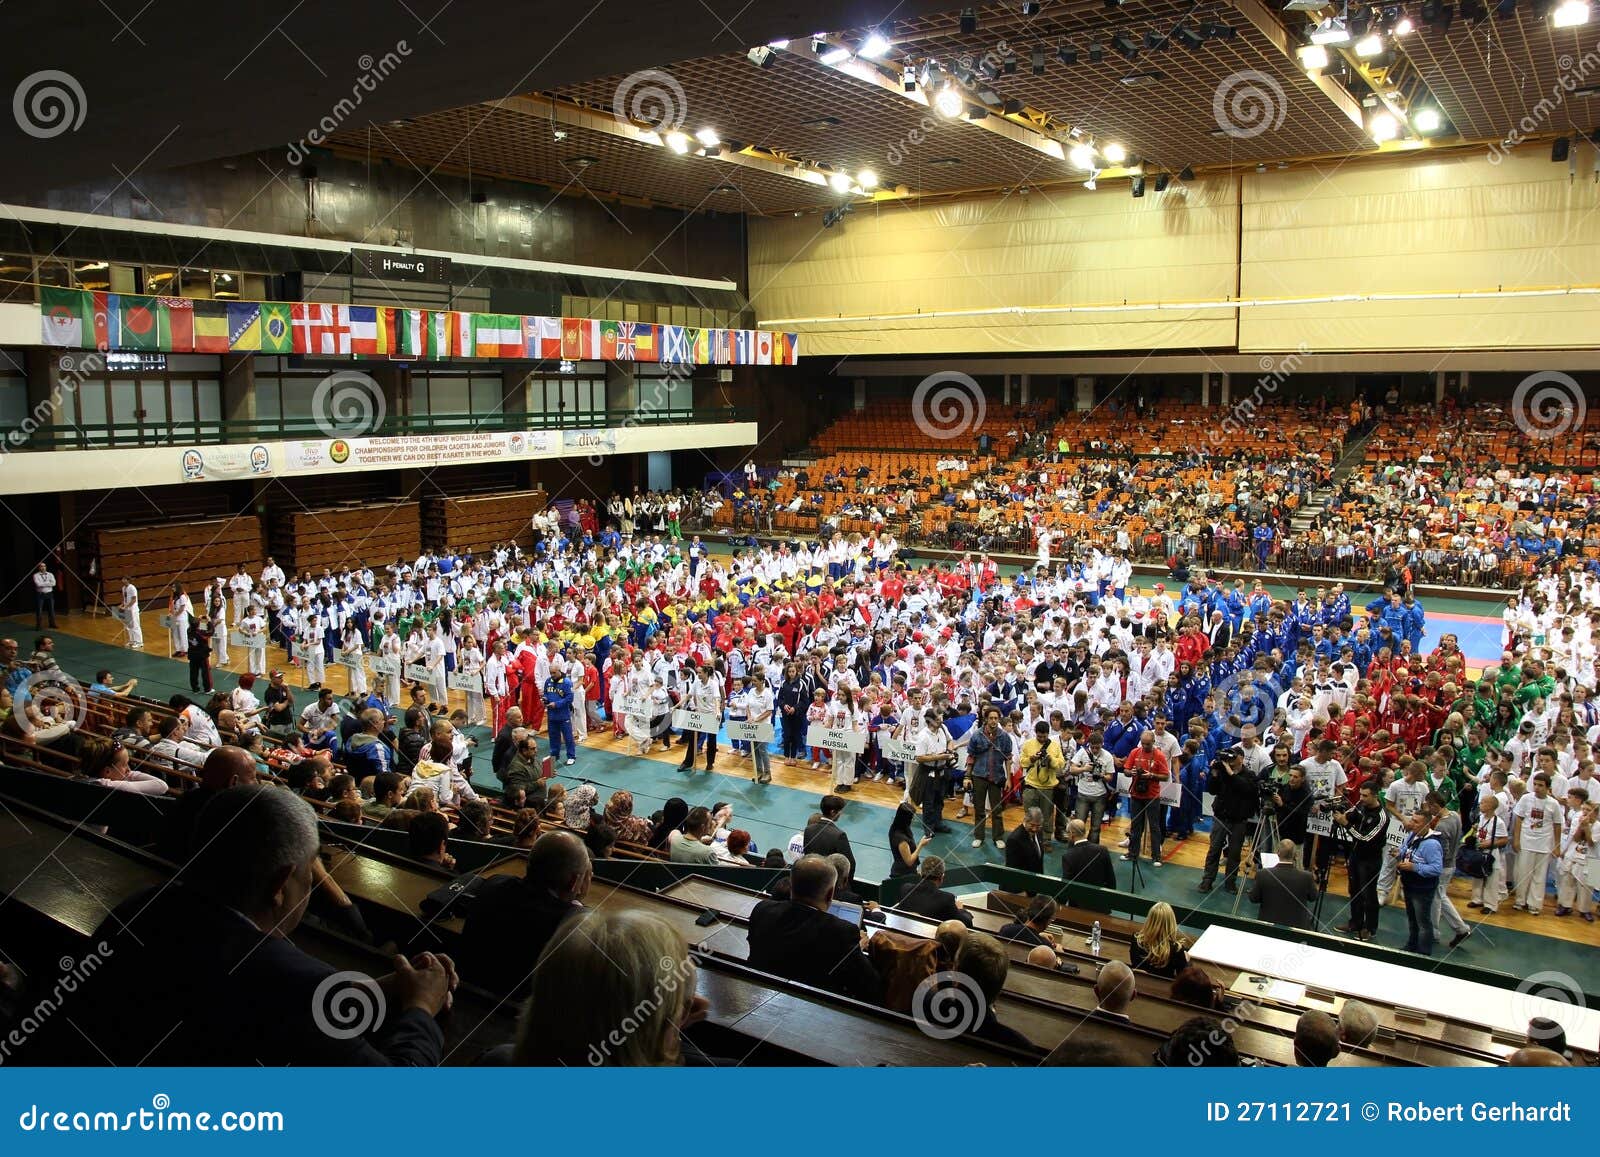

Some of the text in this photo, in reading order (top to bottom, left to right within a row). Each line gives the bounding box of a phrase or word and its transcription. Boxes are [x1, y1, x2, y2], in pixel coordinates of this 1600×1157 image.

[383, 259, 424, 273] H PENALTY G
[578, 433, 600, 446] diva
[354, 447, 404, 455] CHAMPIONSHIPS
[360, 455, 392, 463] TOGETHER
[443, 451, 464, 459] KARATE
[687, 722, 703, 730] ITALY
[828, 731, 843, 739] RKC
[822, 740, 848, 749] RUSSIA
